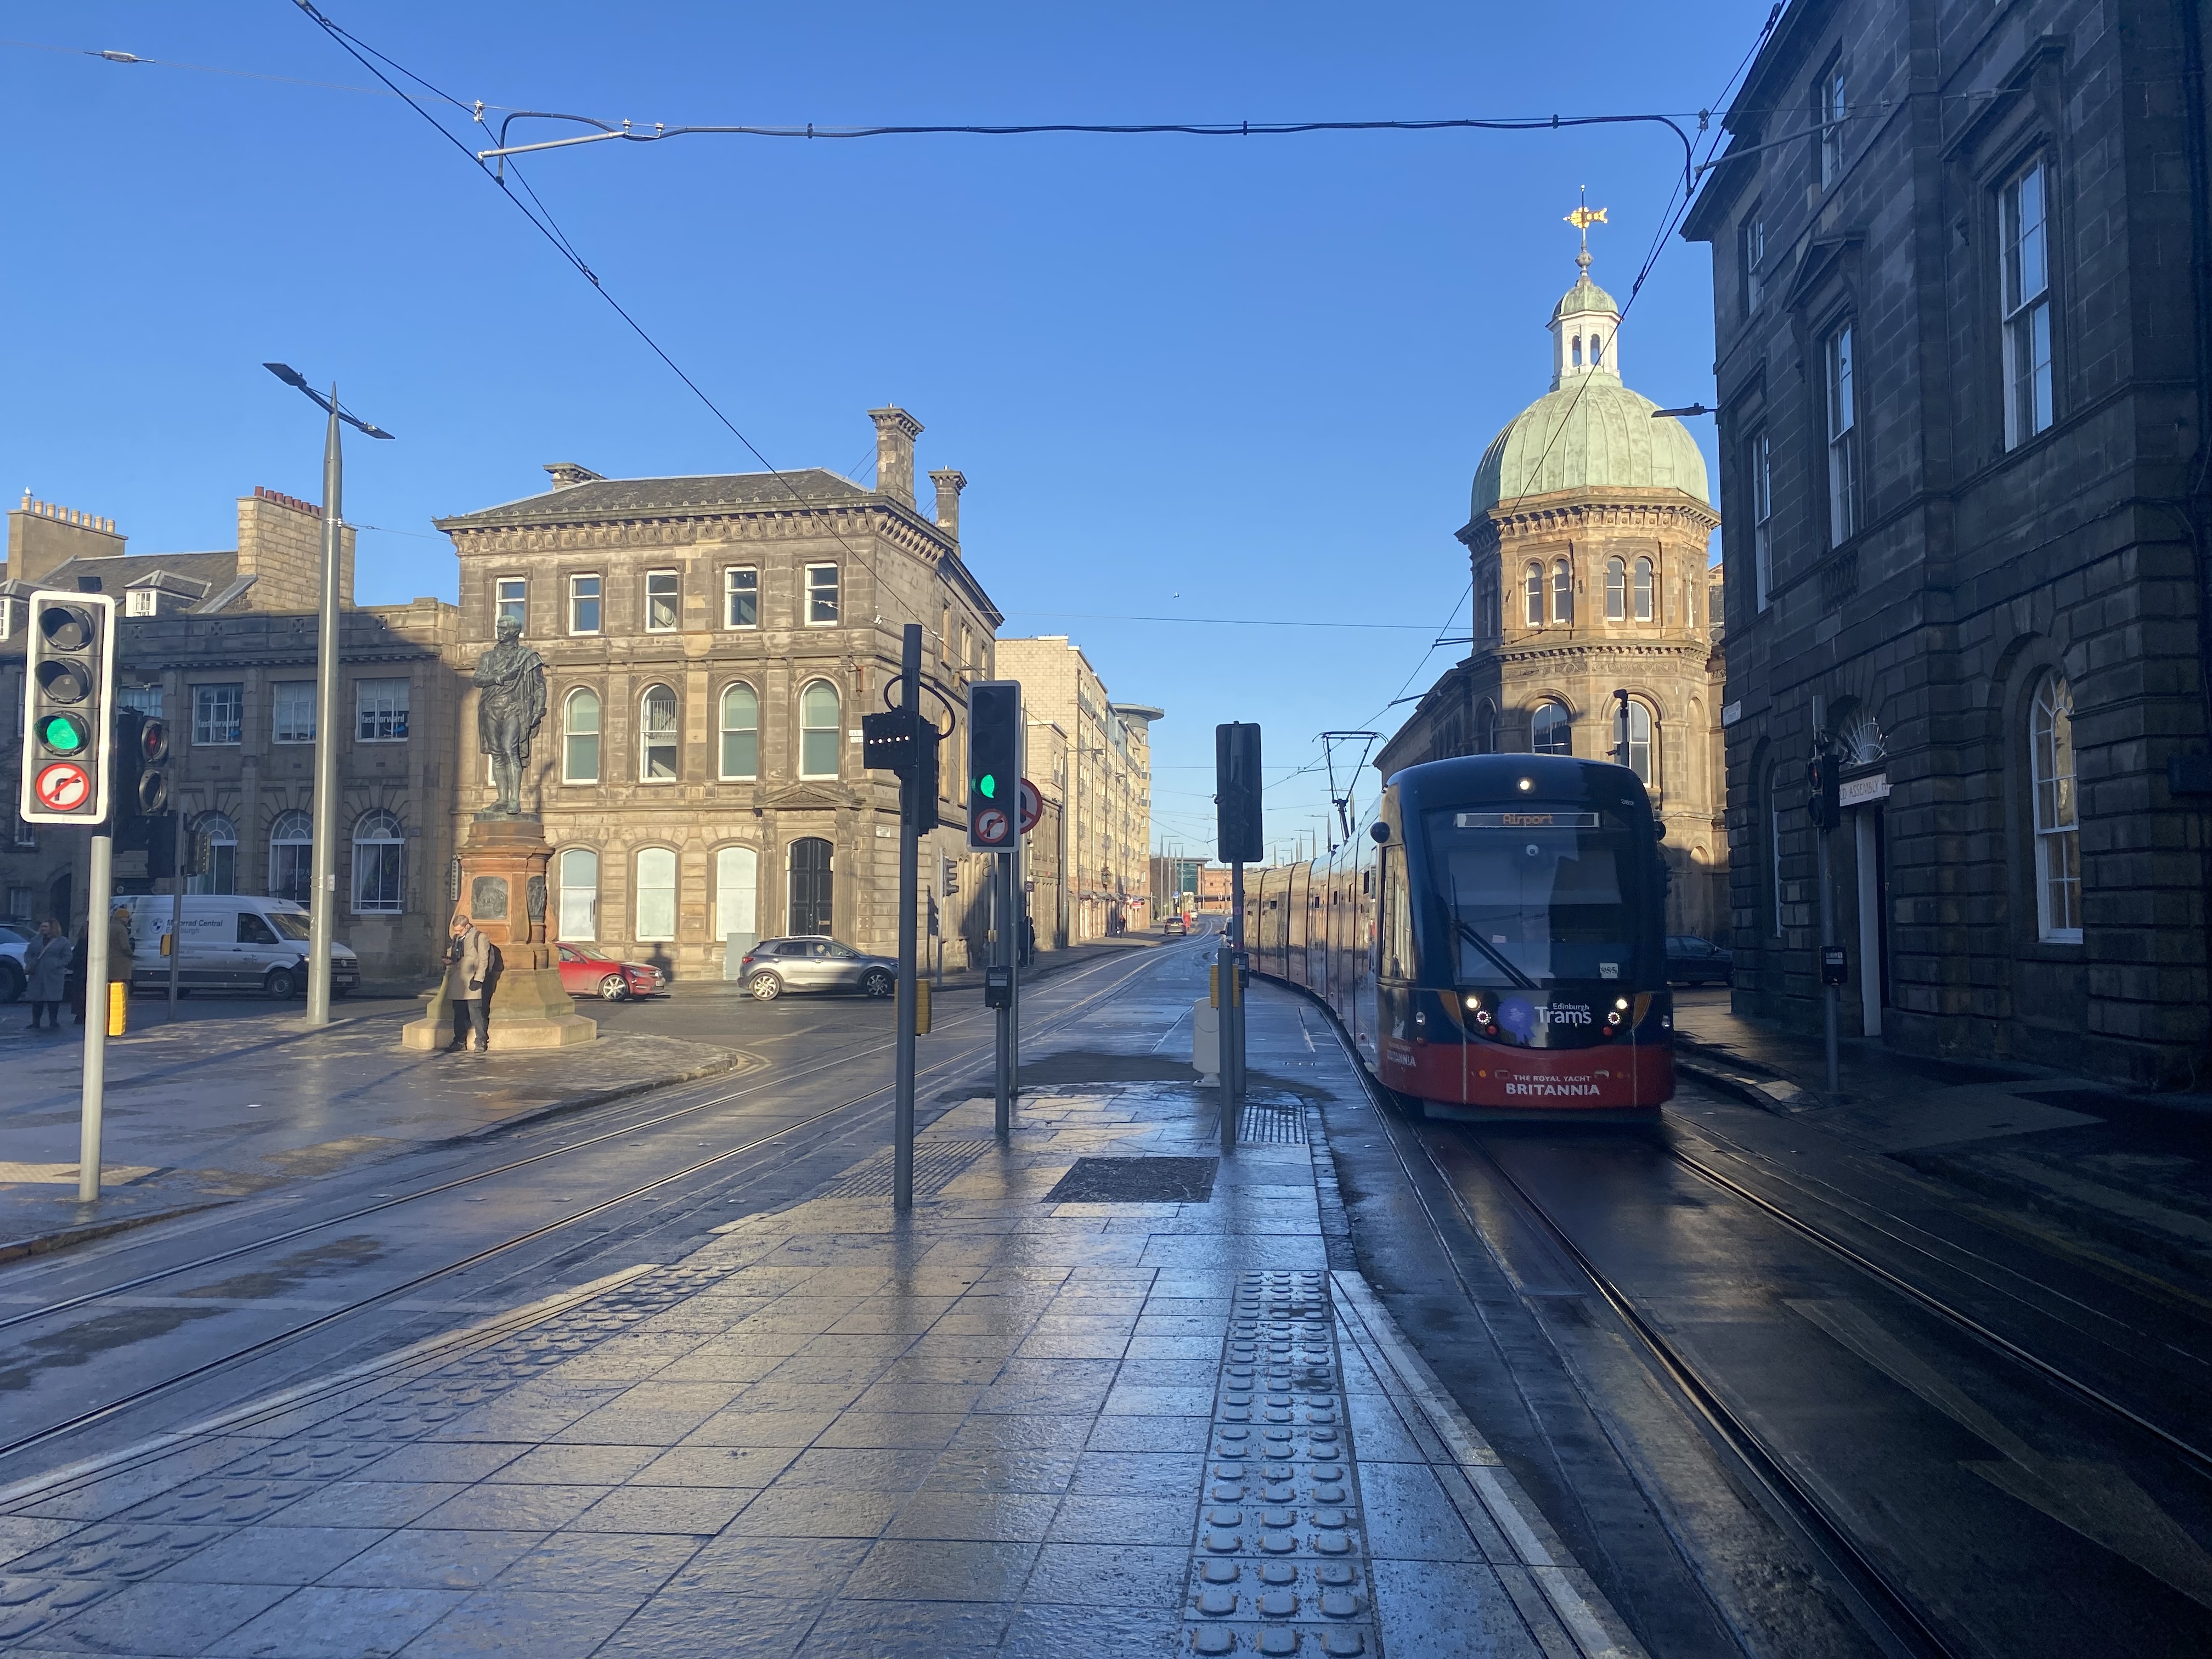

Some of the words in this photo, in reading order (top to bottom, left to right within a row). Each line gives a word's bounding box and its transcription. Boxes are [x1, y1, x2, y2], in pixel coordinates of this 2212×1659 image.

[362, 714, 375, 724] fast
[377, 713, 405, 723] orward
[1849, 780, 1879, 798] ASSEMBLY
[1503, 814, 1553, 826] Airport
[166, 927, 200, 935] Eburgh
[1553, 1002, 1590, 1012] Edinburgh
[1534, 1006, 1592, 1024] Trams
[1505, 1082, 1600, 1096] BRITANNIA
